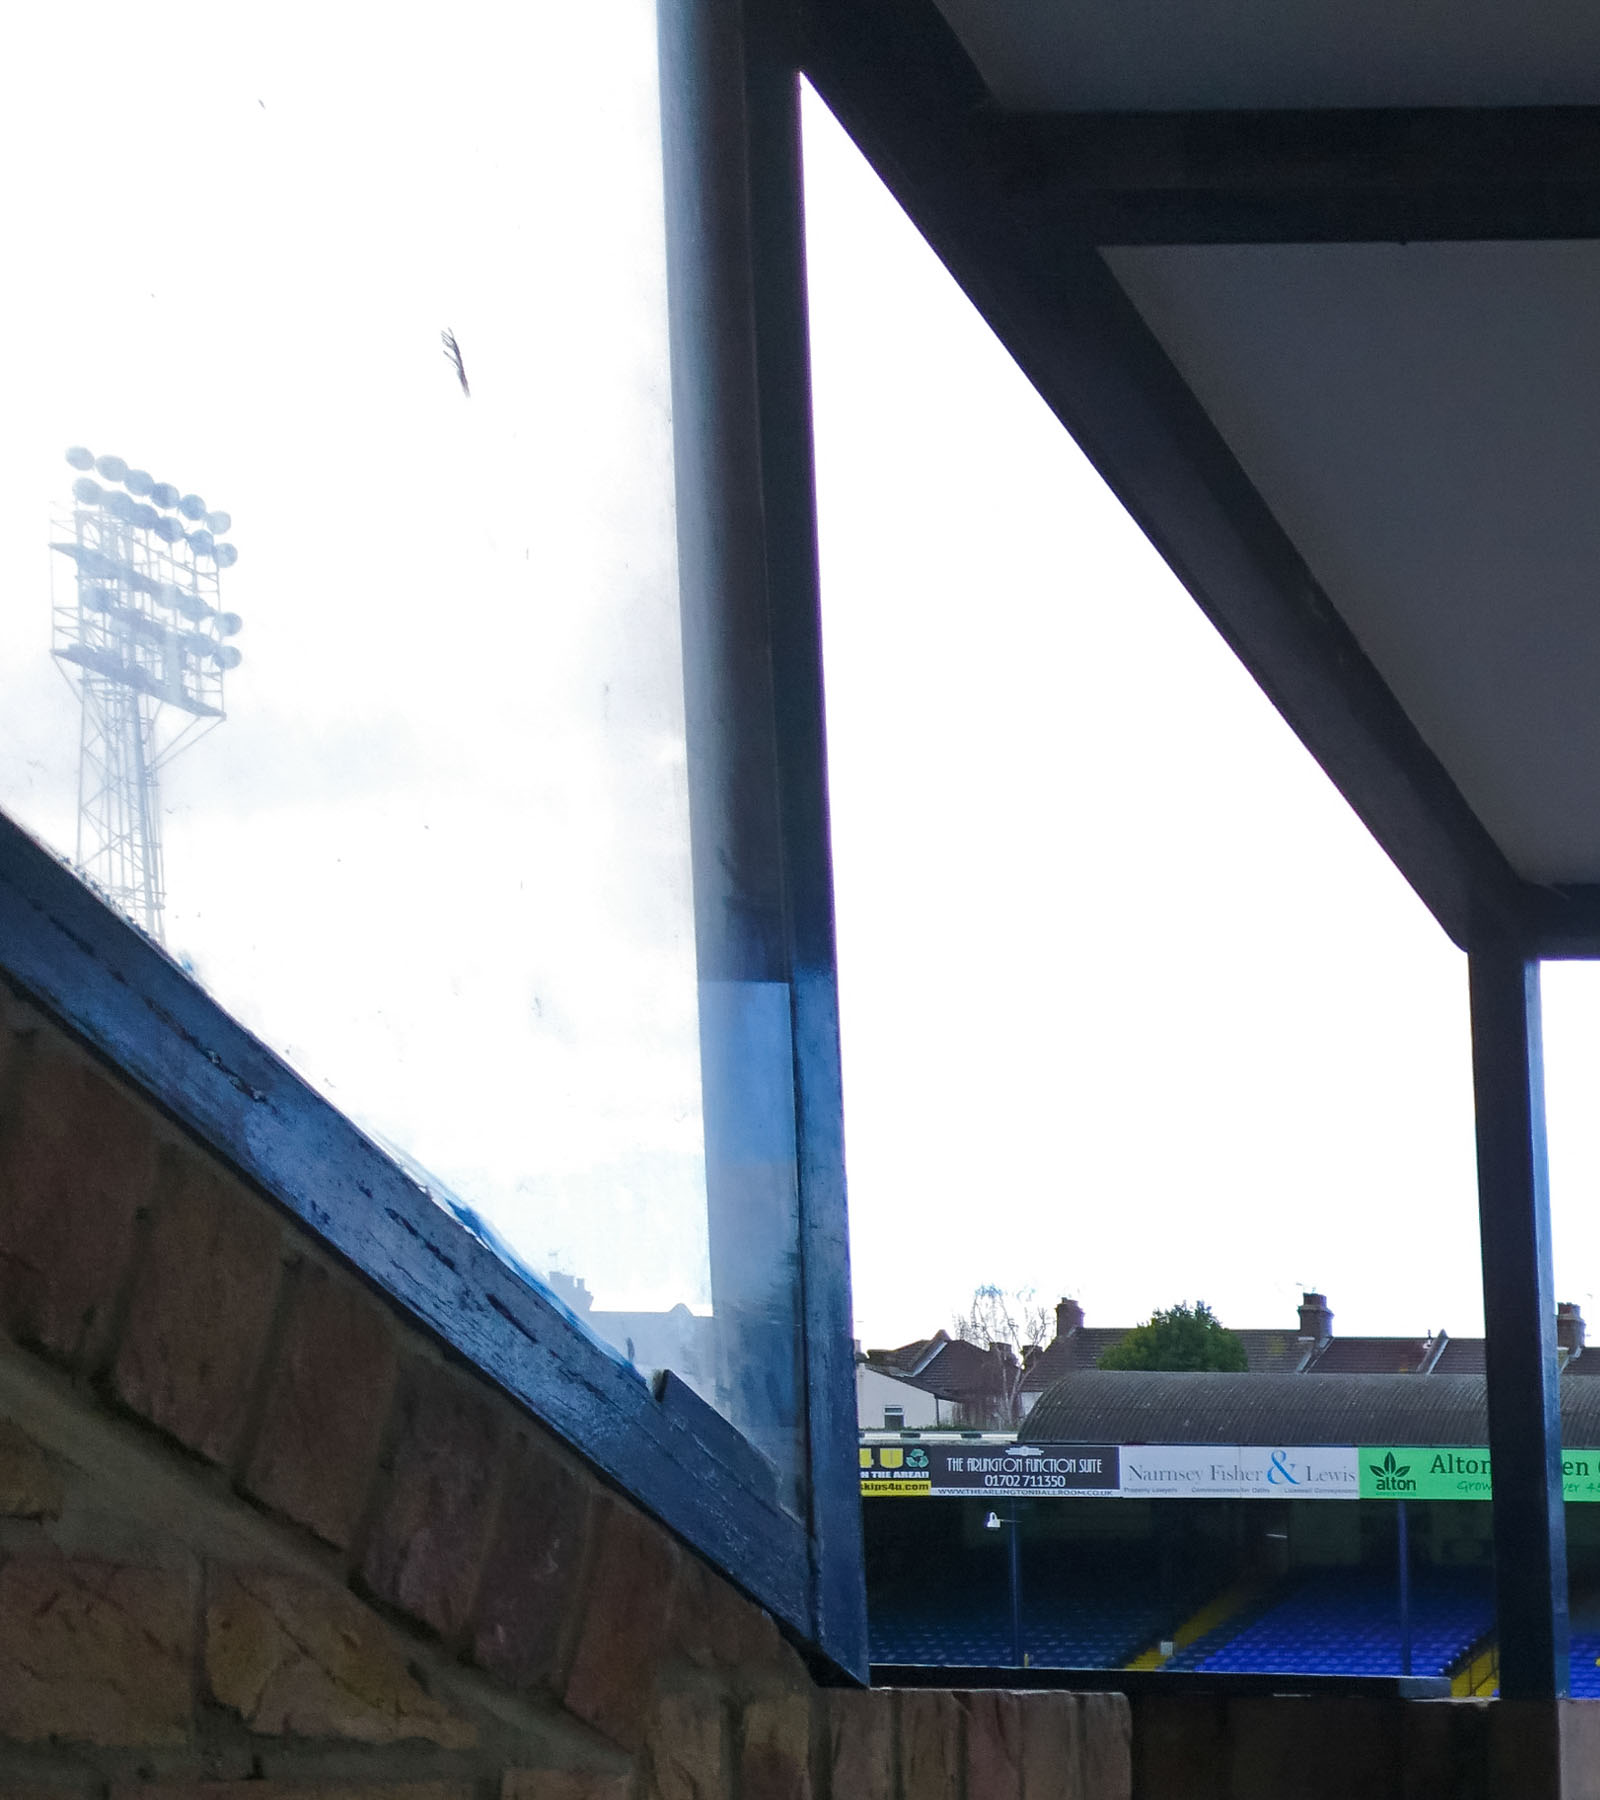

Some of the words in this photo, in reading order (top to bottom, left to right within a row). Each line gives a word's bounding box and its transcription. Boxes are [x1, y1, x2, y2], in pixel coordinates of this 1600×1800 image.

[946, 1457, 964, 1473] THE
[966, 1457, 1024, 1473] ARLINGTON
[1025, 1457, 1076, 1473] FUNCTION
[1078, 1458, 1103, 1474] SUITE
[1210, 1464, 1263, 1483] Fisher
[1266, 1450, 1301, 1486] &
[1306, 1465, 1357, 1483] Lewis
[984, 1474, 1020, 1488] 01702
[1023, 1474, 1066, 1488] 711350
[1376, 1478, 1417, 1491] alton
